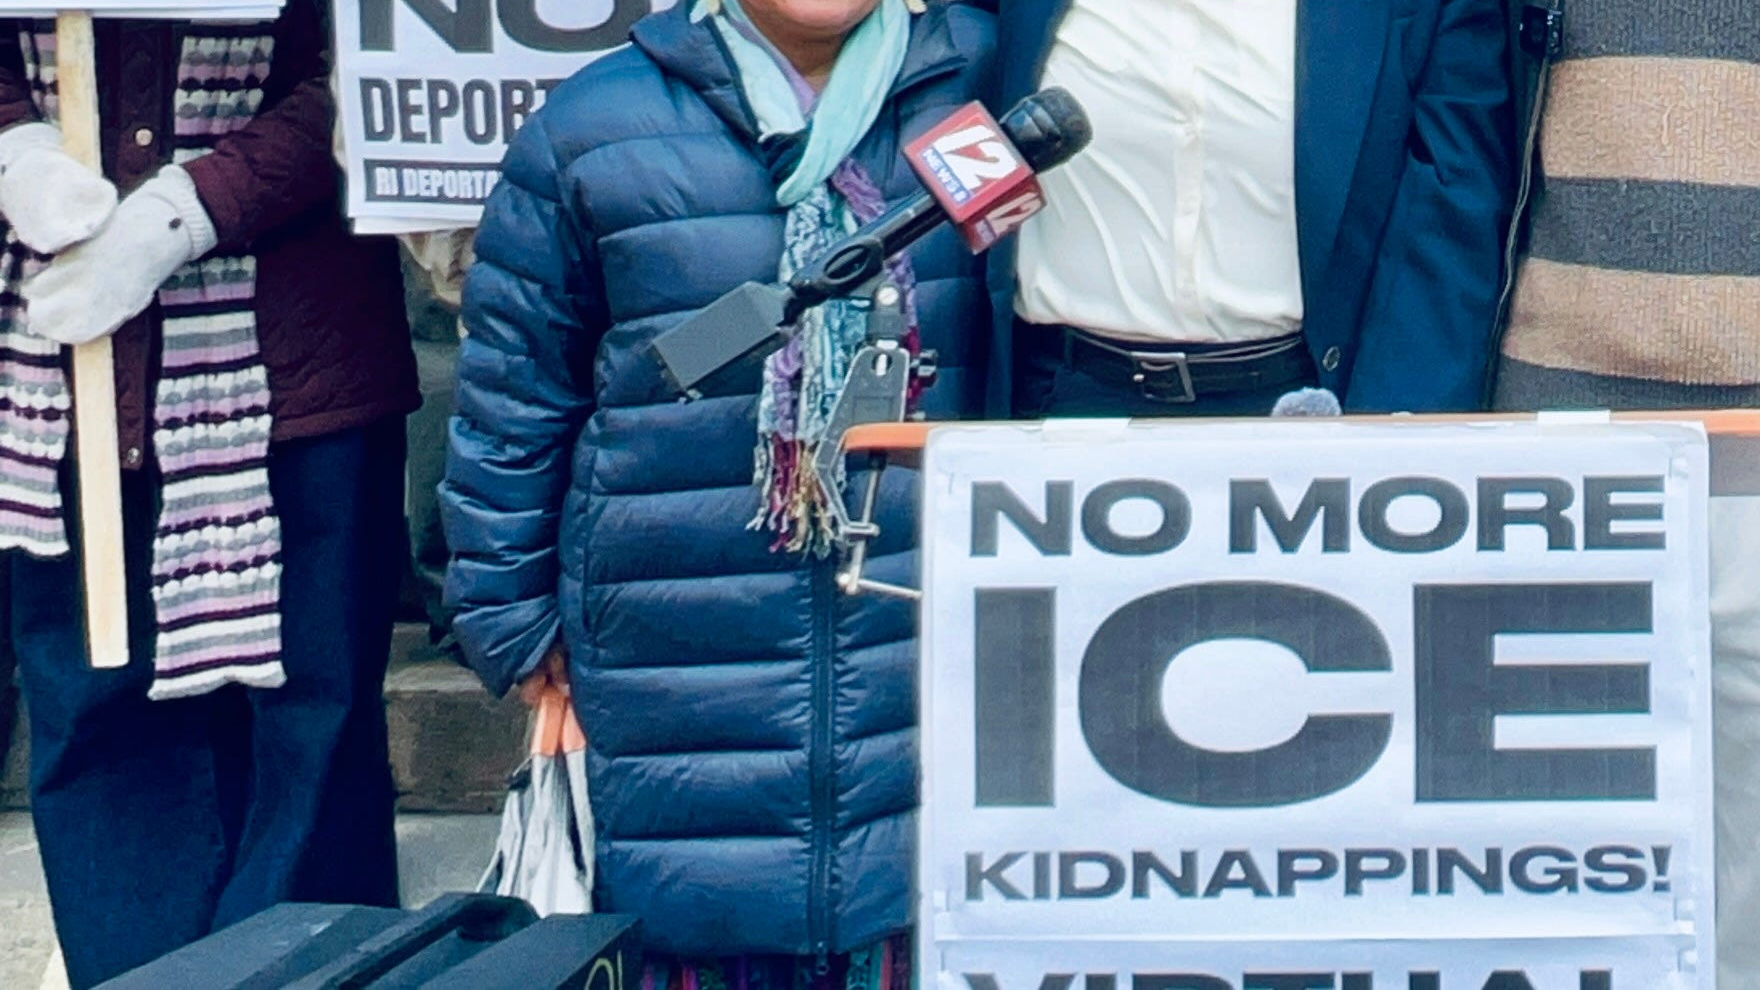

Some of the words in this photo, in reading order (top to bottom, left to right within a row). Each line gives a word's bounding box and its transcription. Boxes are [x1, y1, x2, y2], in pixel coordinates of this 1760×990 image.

[375, 166, 399, 196] RI
[969, 477, 1192, 558] NO
[1228, 475, 1667, 555] MORE
[973, 579, 1659, 809] ICE
[964, 843, 1673, 902] KIDNAPPINGS!
